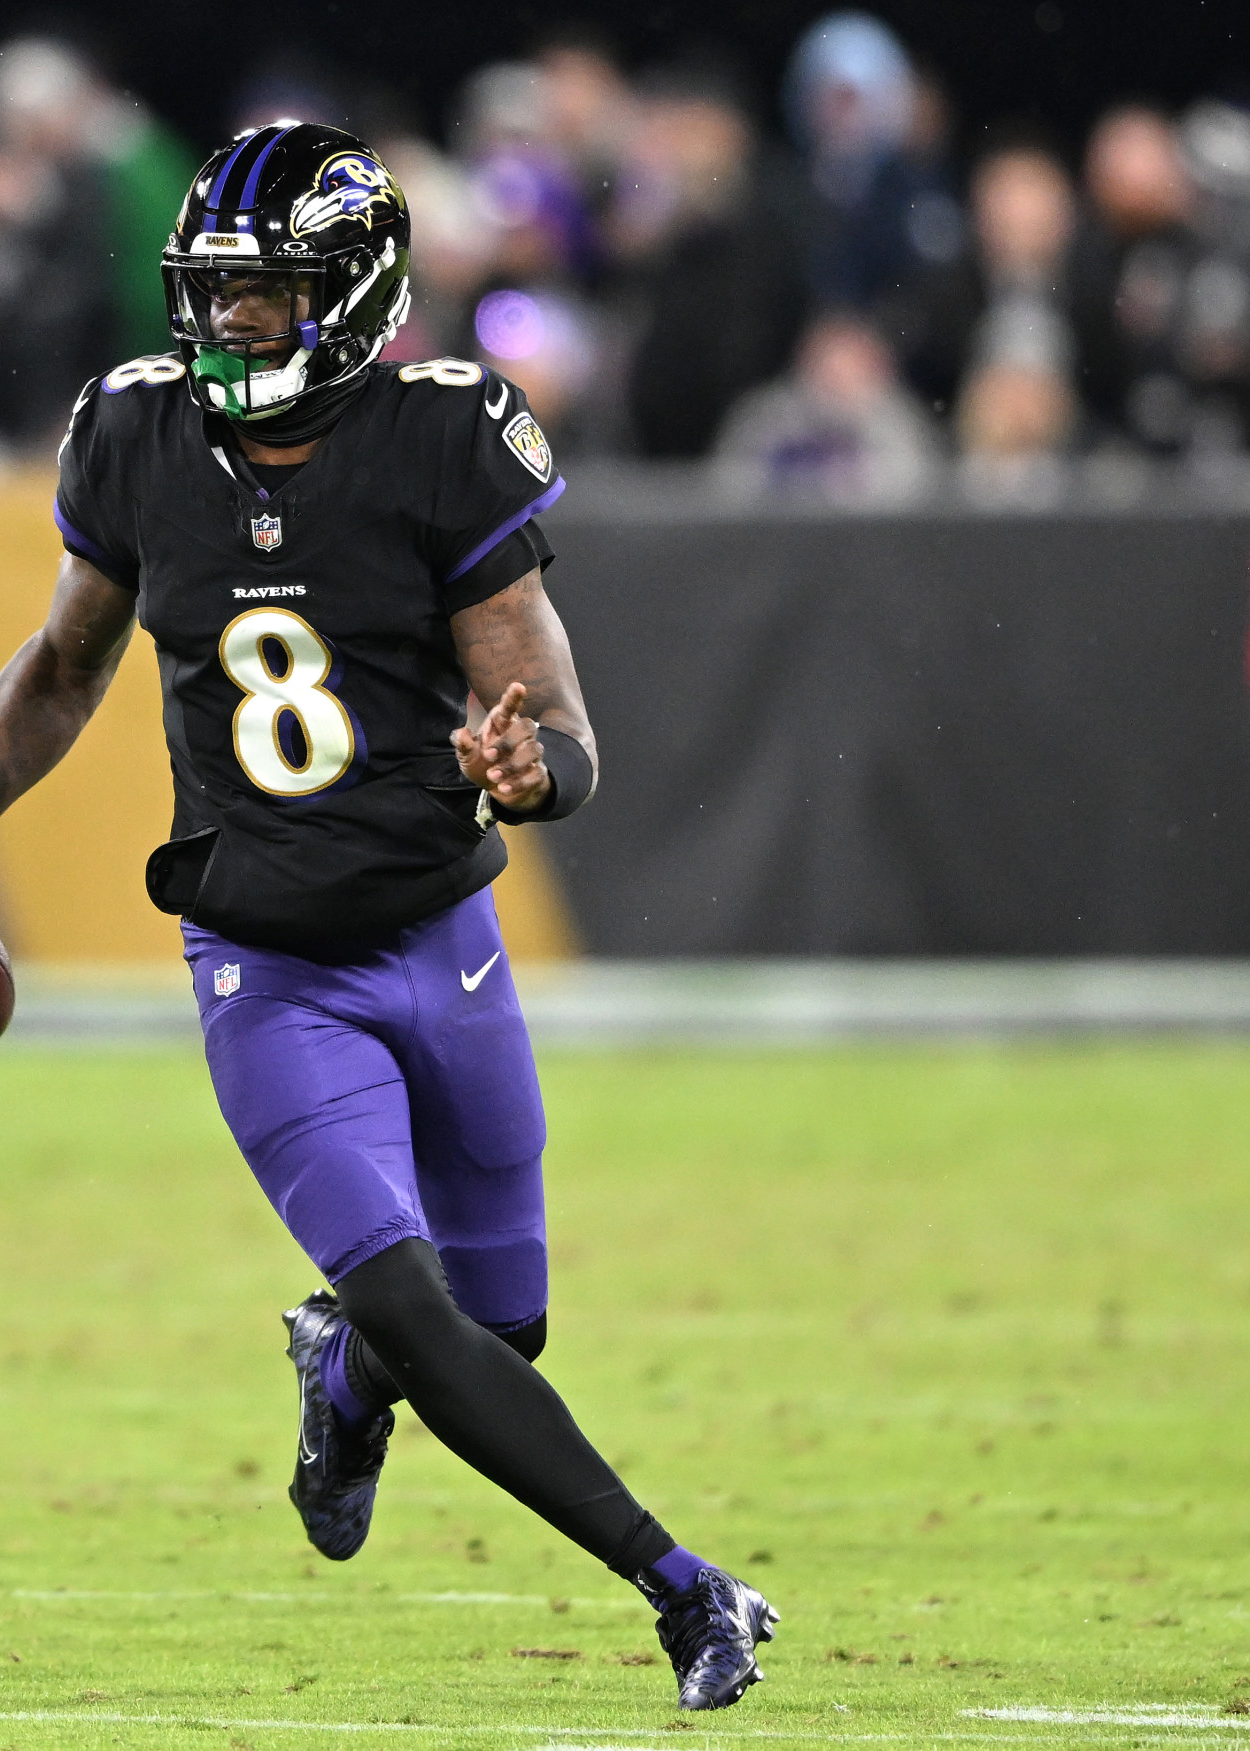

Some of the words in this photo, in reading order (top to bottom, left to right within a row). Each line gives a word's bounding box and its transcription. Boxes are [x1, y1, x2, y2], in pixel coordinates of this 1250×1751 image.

[205, 236, 239, 248] RAVENS
[104, 358, 187, 391] 8
[398, 360, 483, 387] 8
[257, 531, 278, 545] NFL
[232, 585, 307, 598] RAVENS
[218, 606, 356, 797] 8
[219, 976, 236, 990] NFL
